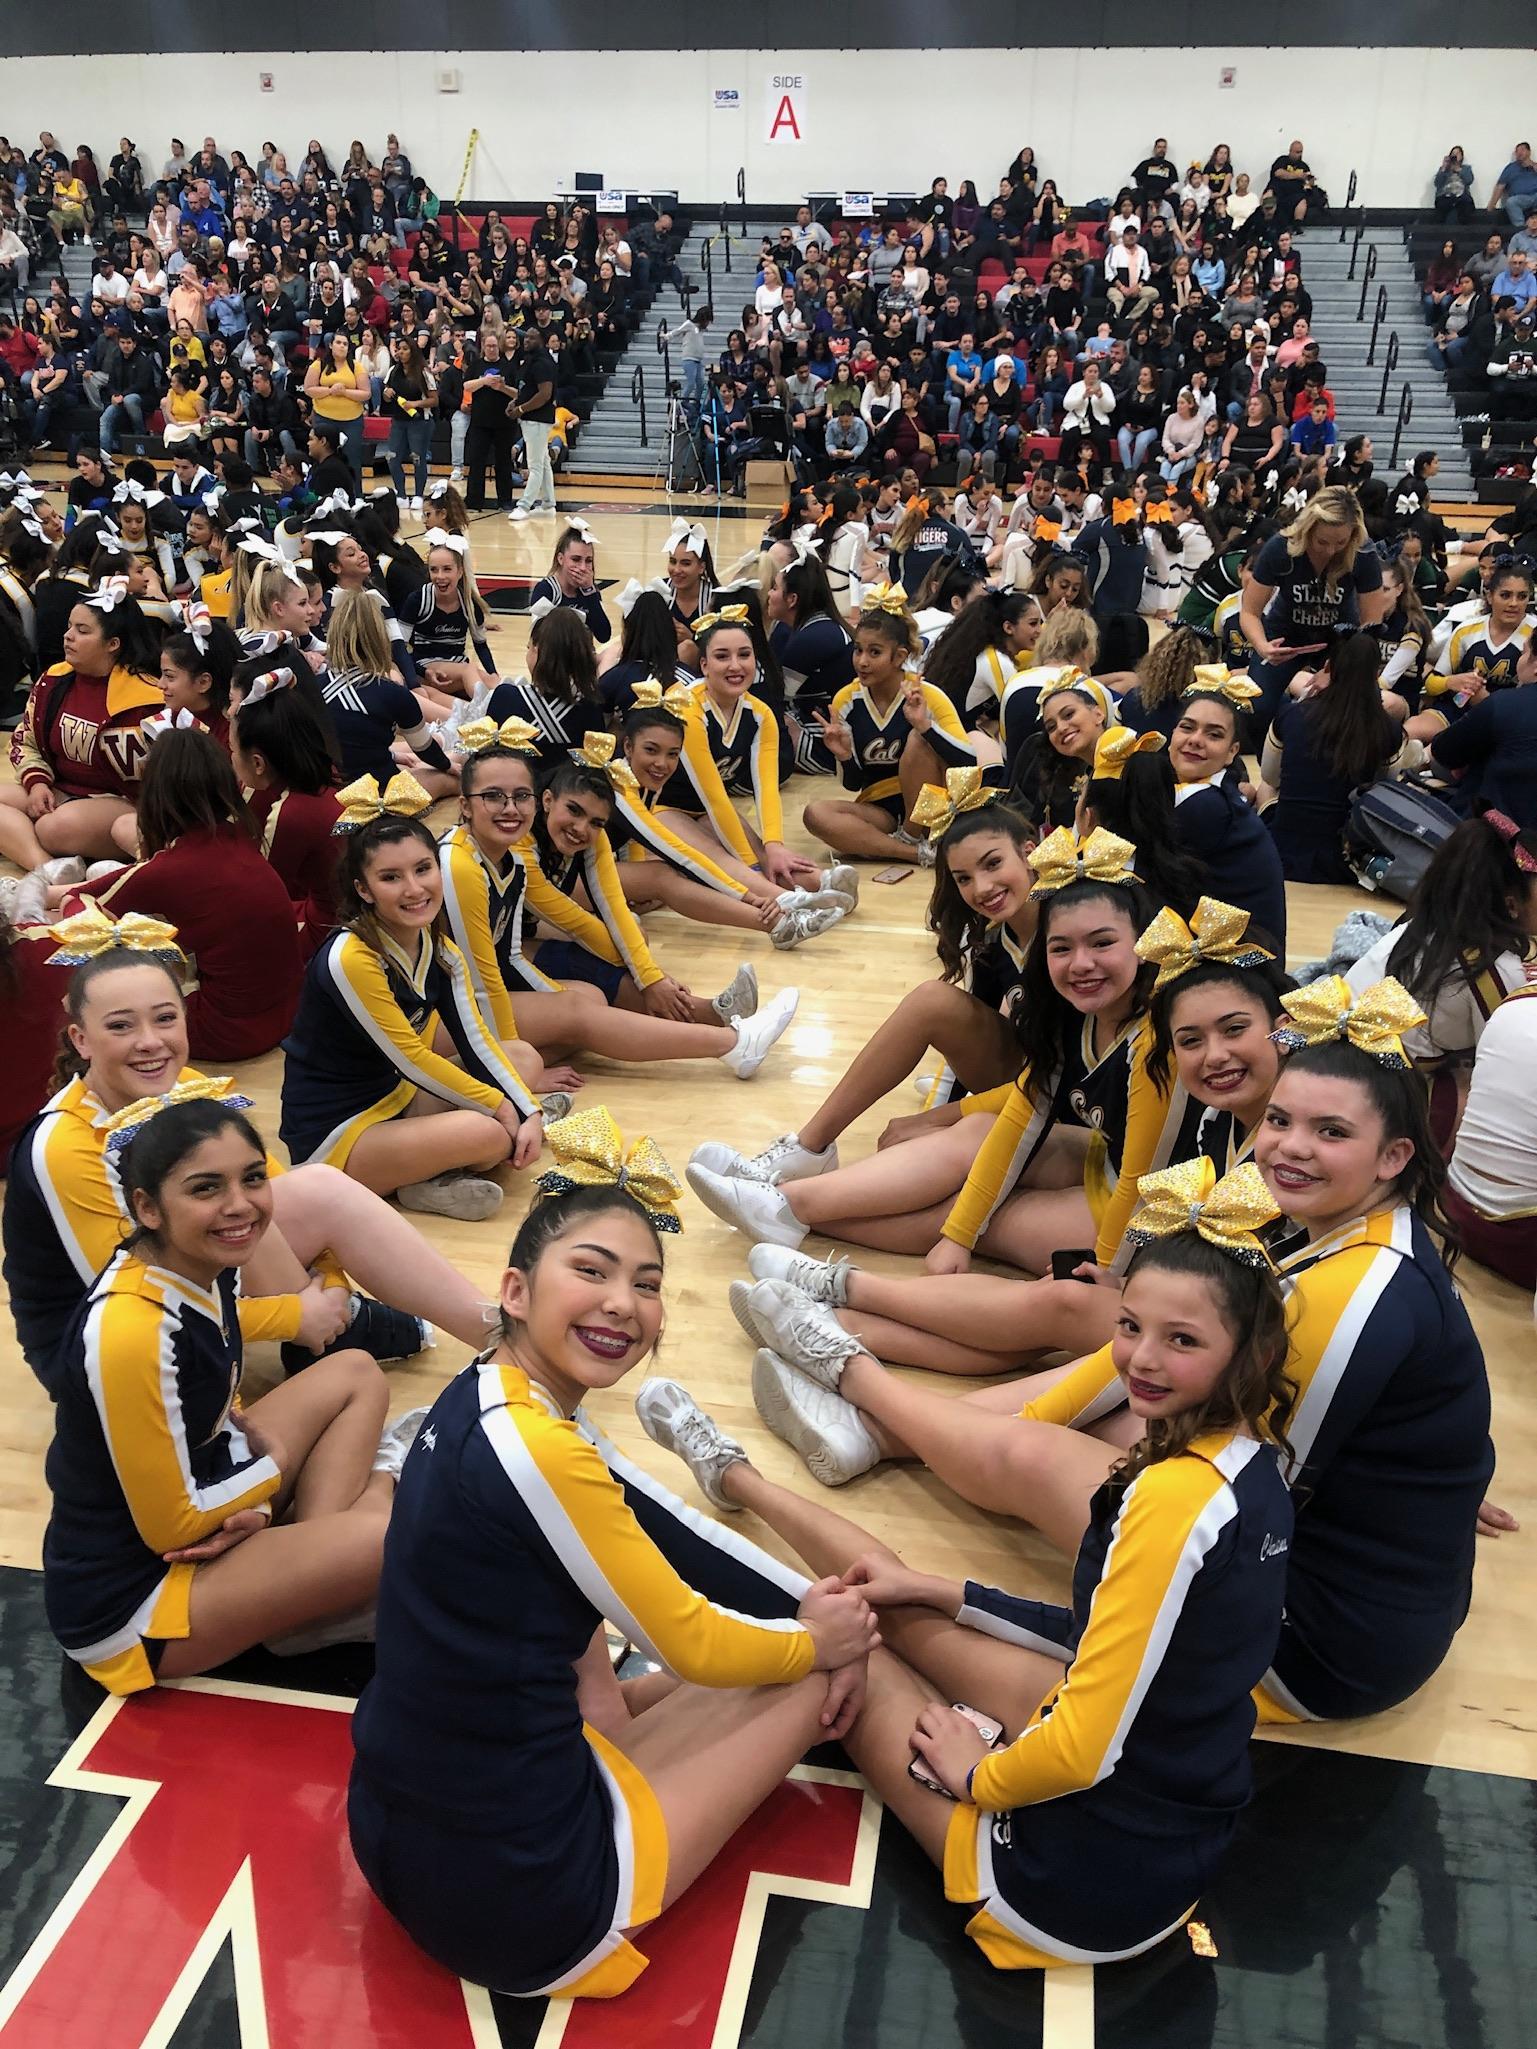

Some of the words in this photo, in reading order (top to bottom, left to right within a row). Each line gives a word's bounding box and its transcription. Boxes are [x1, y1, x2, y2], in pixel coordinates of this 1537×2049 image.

[772, 76, 802, 88] SIDE
[769, 95, 801, 139] A
[59, 712, 99, 767] W
[864, 737, 901, 765] Cal
